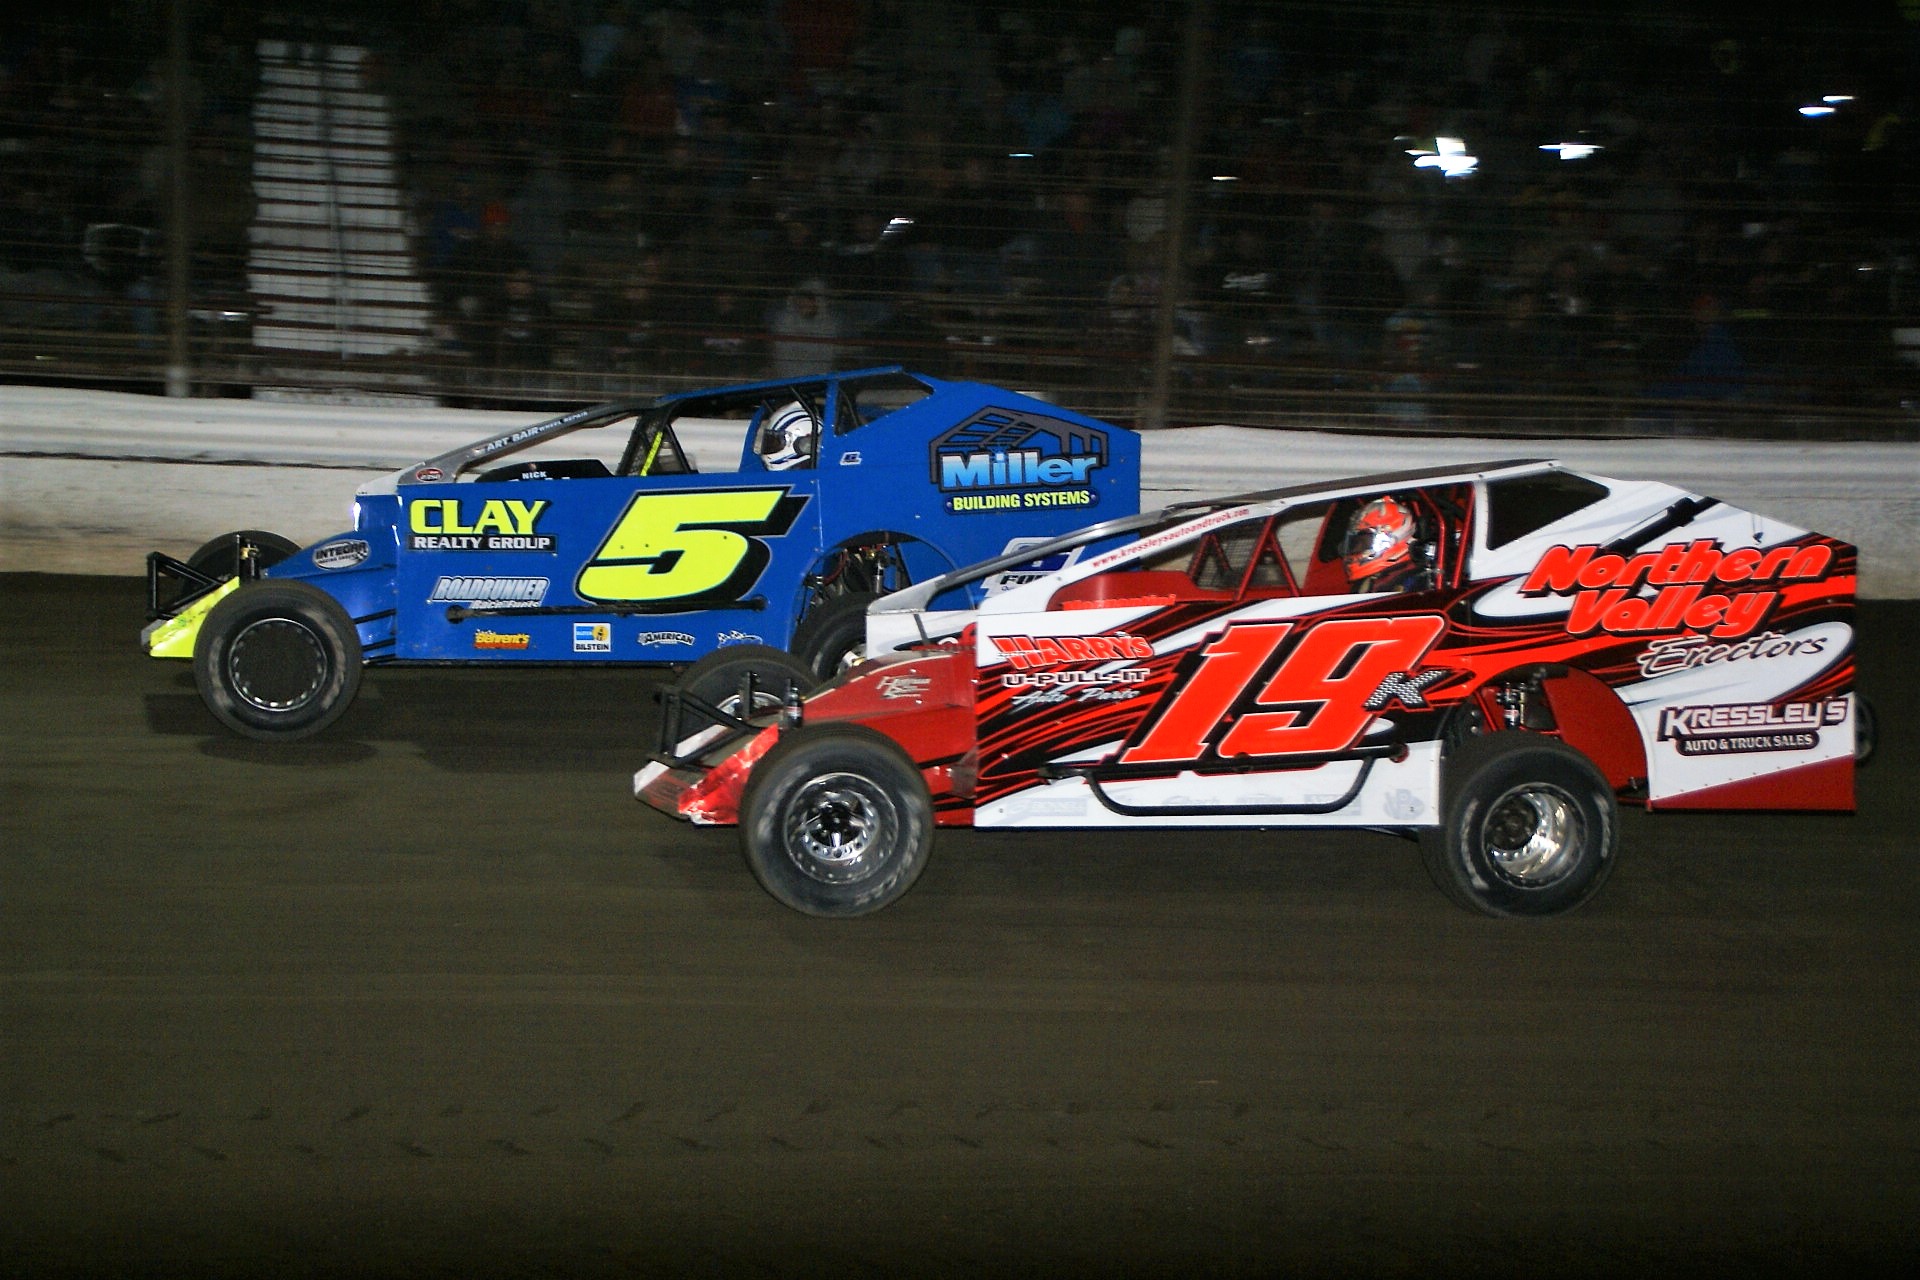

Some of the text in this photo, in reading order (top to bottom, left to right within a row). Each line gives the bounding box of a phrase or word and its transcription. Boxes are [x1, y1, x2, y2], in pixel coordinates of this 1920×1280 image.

[487, 436, 510, 452] ART
[512, 426, 539, 442] BAIR
[522, 471, 547, 479] NICK
[941, 450, 1098, 488] Miller
[953, 490, 1090, 511] BUILDING SYSTEMS
[410, 499, 548, 534] CLAY
[414, 536, 551, 549] REALTY GROUP
[577, 488, 785, 601] 5
[1521, 539, 1833, 591] Northern
[433, 577, 549, 600] ROADRUNNER
[1566, 584, 1778, 638] Valley
[644, 631, 694, 645] AMERICAN
[1636, 632, 1829, 678] Erectors
[1002, 668, 1150, 688] U-PULL-IT
[1685, 734, 1814, 752] AUTO & TRUCK SALES
